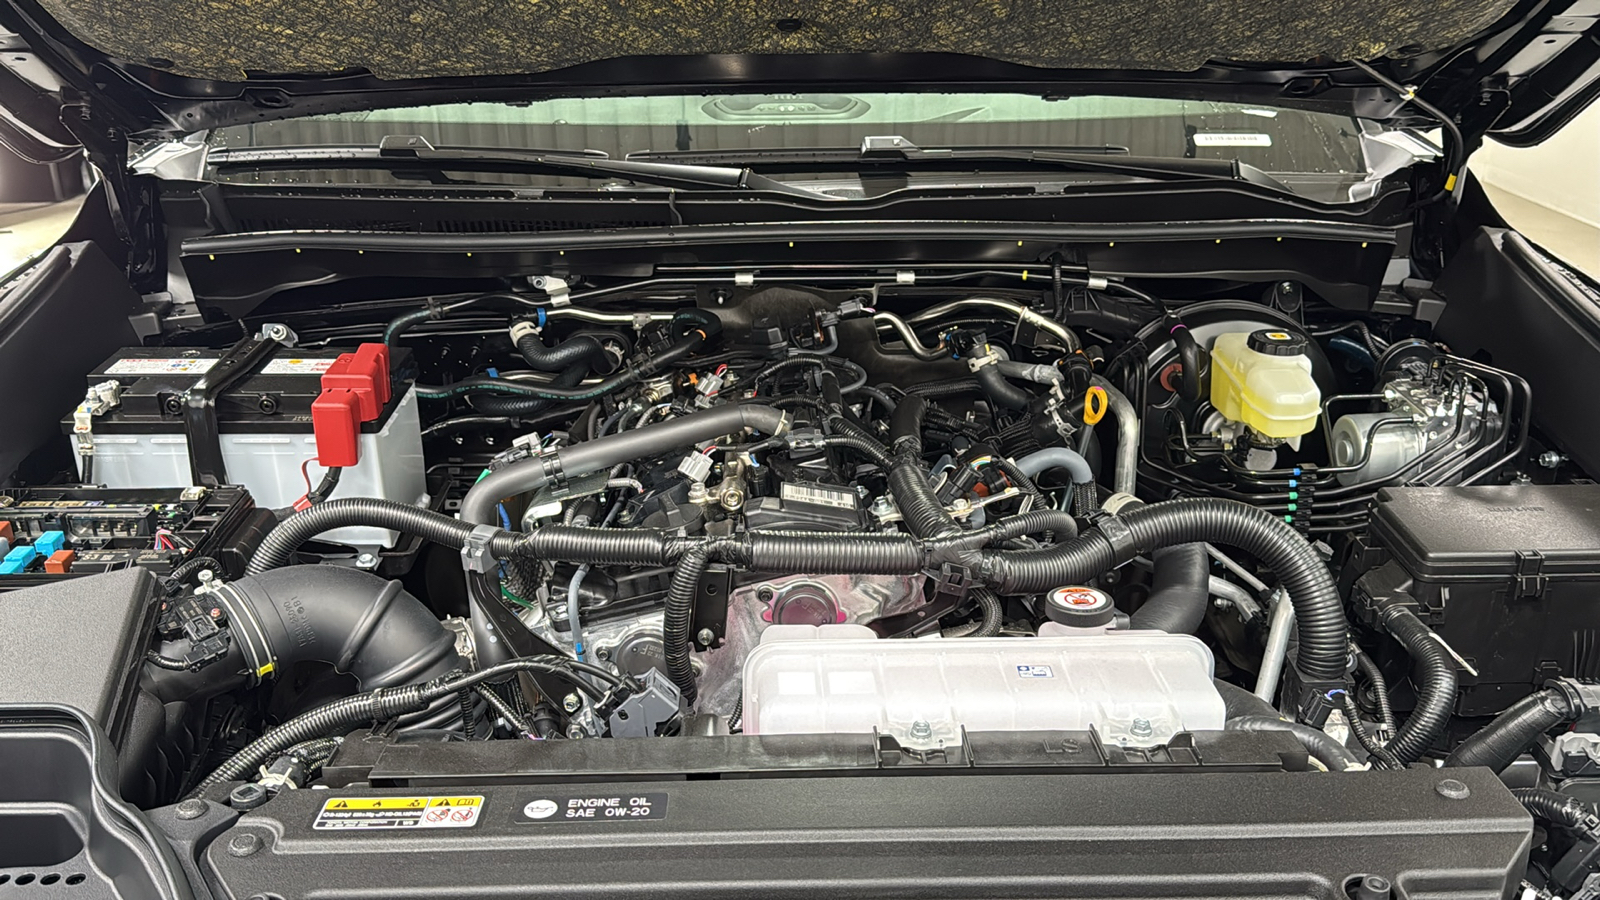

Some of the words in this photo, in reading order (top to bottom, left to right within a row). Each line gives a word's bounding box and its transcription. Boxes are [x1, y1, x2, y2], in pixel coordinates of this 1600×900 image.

[567, 798, 621, 808] ENGINE
[629, 797, 652, 806] OIL
[565, 808, 597, 818] SAE
[604, 807, 651, 817] 0W-20
